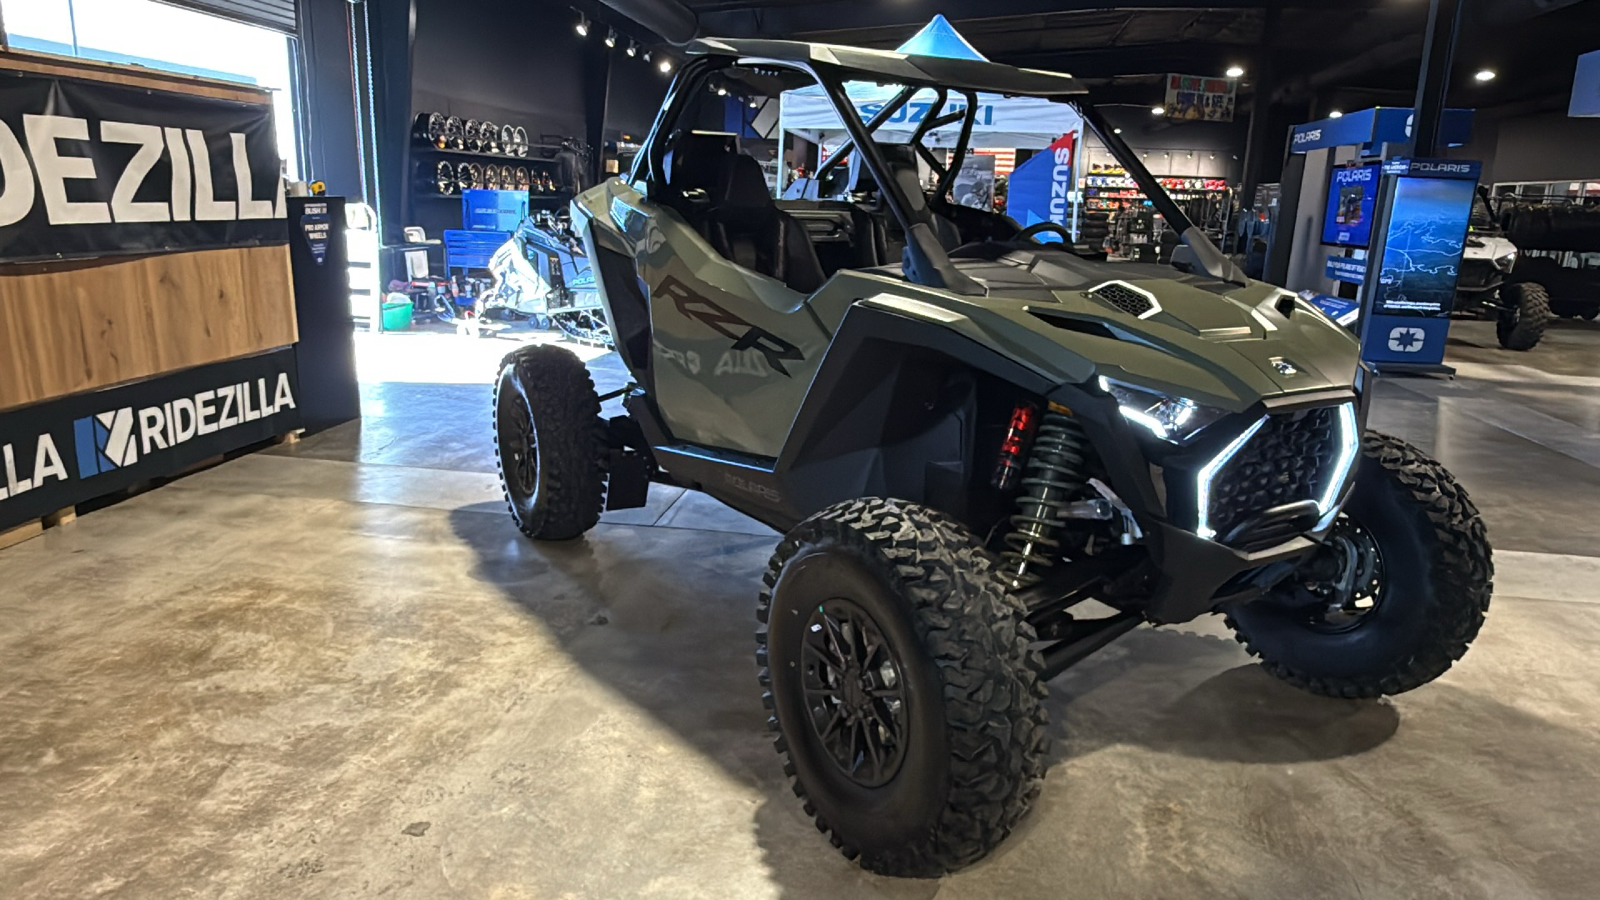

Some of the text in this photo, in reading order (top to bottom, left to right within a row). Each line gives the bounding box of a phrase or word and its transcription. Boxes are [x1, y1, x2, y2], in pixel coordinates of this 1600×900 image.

[1293, 129, 1322, 144] POLARIS
[1410, 162, 1470, 173] POLARIS
[1049, 147, 1070, 238] SUZUK
[1336, 168, 1372, 183] POLARIS
[652, 275, 805, 378] RZR
[138, 372, 297, 456] RIDEZILLA
[0, 432, 69, 501] LA
